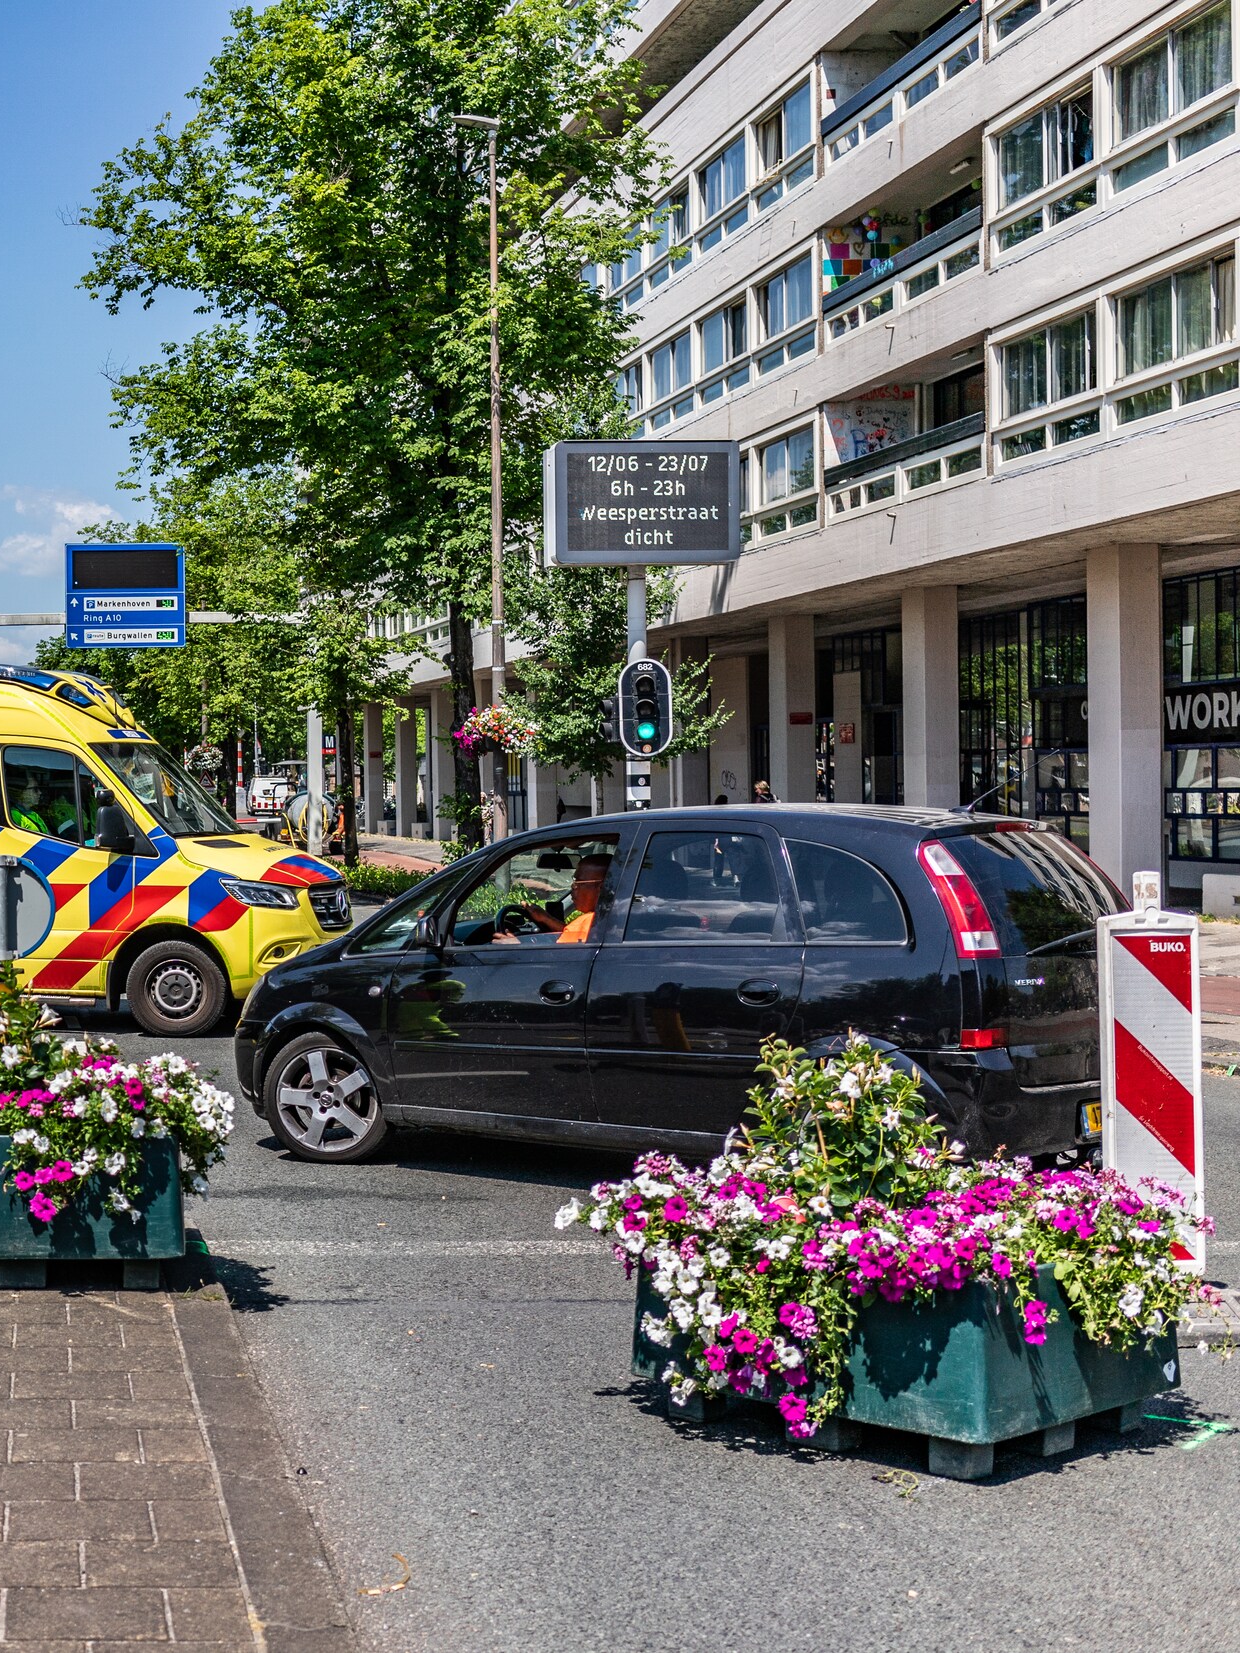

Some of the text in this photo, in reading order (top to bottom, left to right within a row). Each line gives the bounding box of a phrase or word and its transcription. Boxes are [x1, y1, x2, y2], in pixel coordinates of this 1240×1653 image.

[587, 455, 639, 476] 12/06
[658, 455, 709, 476] 23/07
[611, 480, 634, 496] 6h
[653, 480, 686, 496] 23h
[579, 505, 719, 524] Weesperstraat
[624, 528, 674, 545] dicht
[97, 600, 151, 608] Markenhoven
[83, 614, 122, 624] Ring A10
[107, 632, 153, 641] Burgwallen
[637, 663, 653, 671] 682
